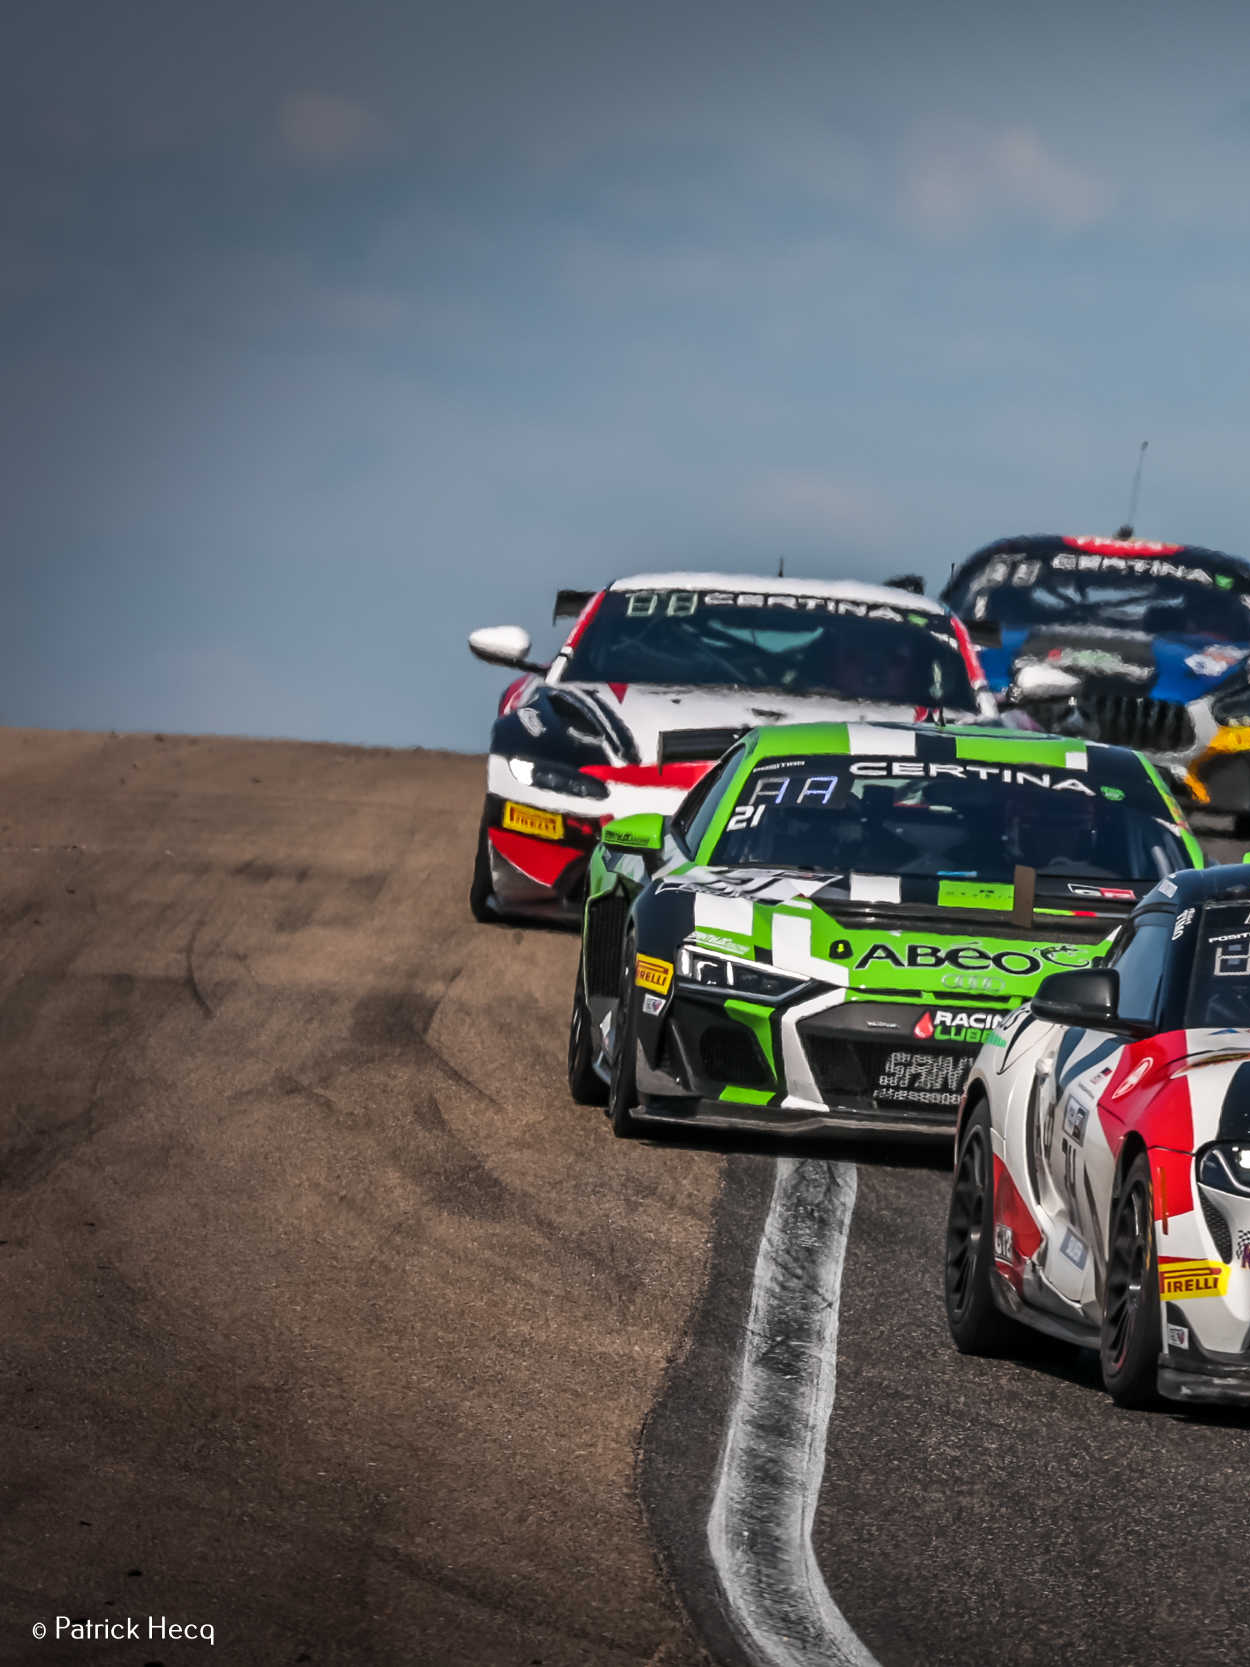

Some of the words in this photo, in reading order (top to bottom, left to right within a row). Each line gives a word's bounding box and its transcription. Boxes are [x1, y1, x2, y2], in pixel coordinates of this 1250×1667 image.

[849, 761, 1097, 797] CERTINA
[726, 804, 766, 832] 21
[637, 960, 669, 987] RELLI
